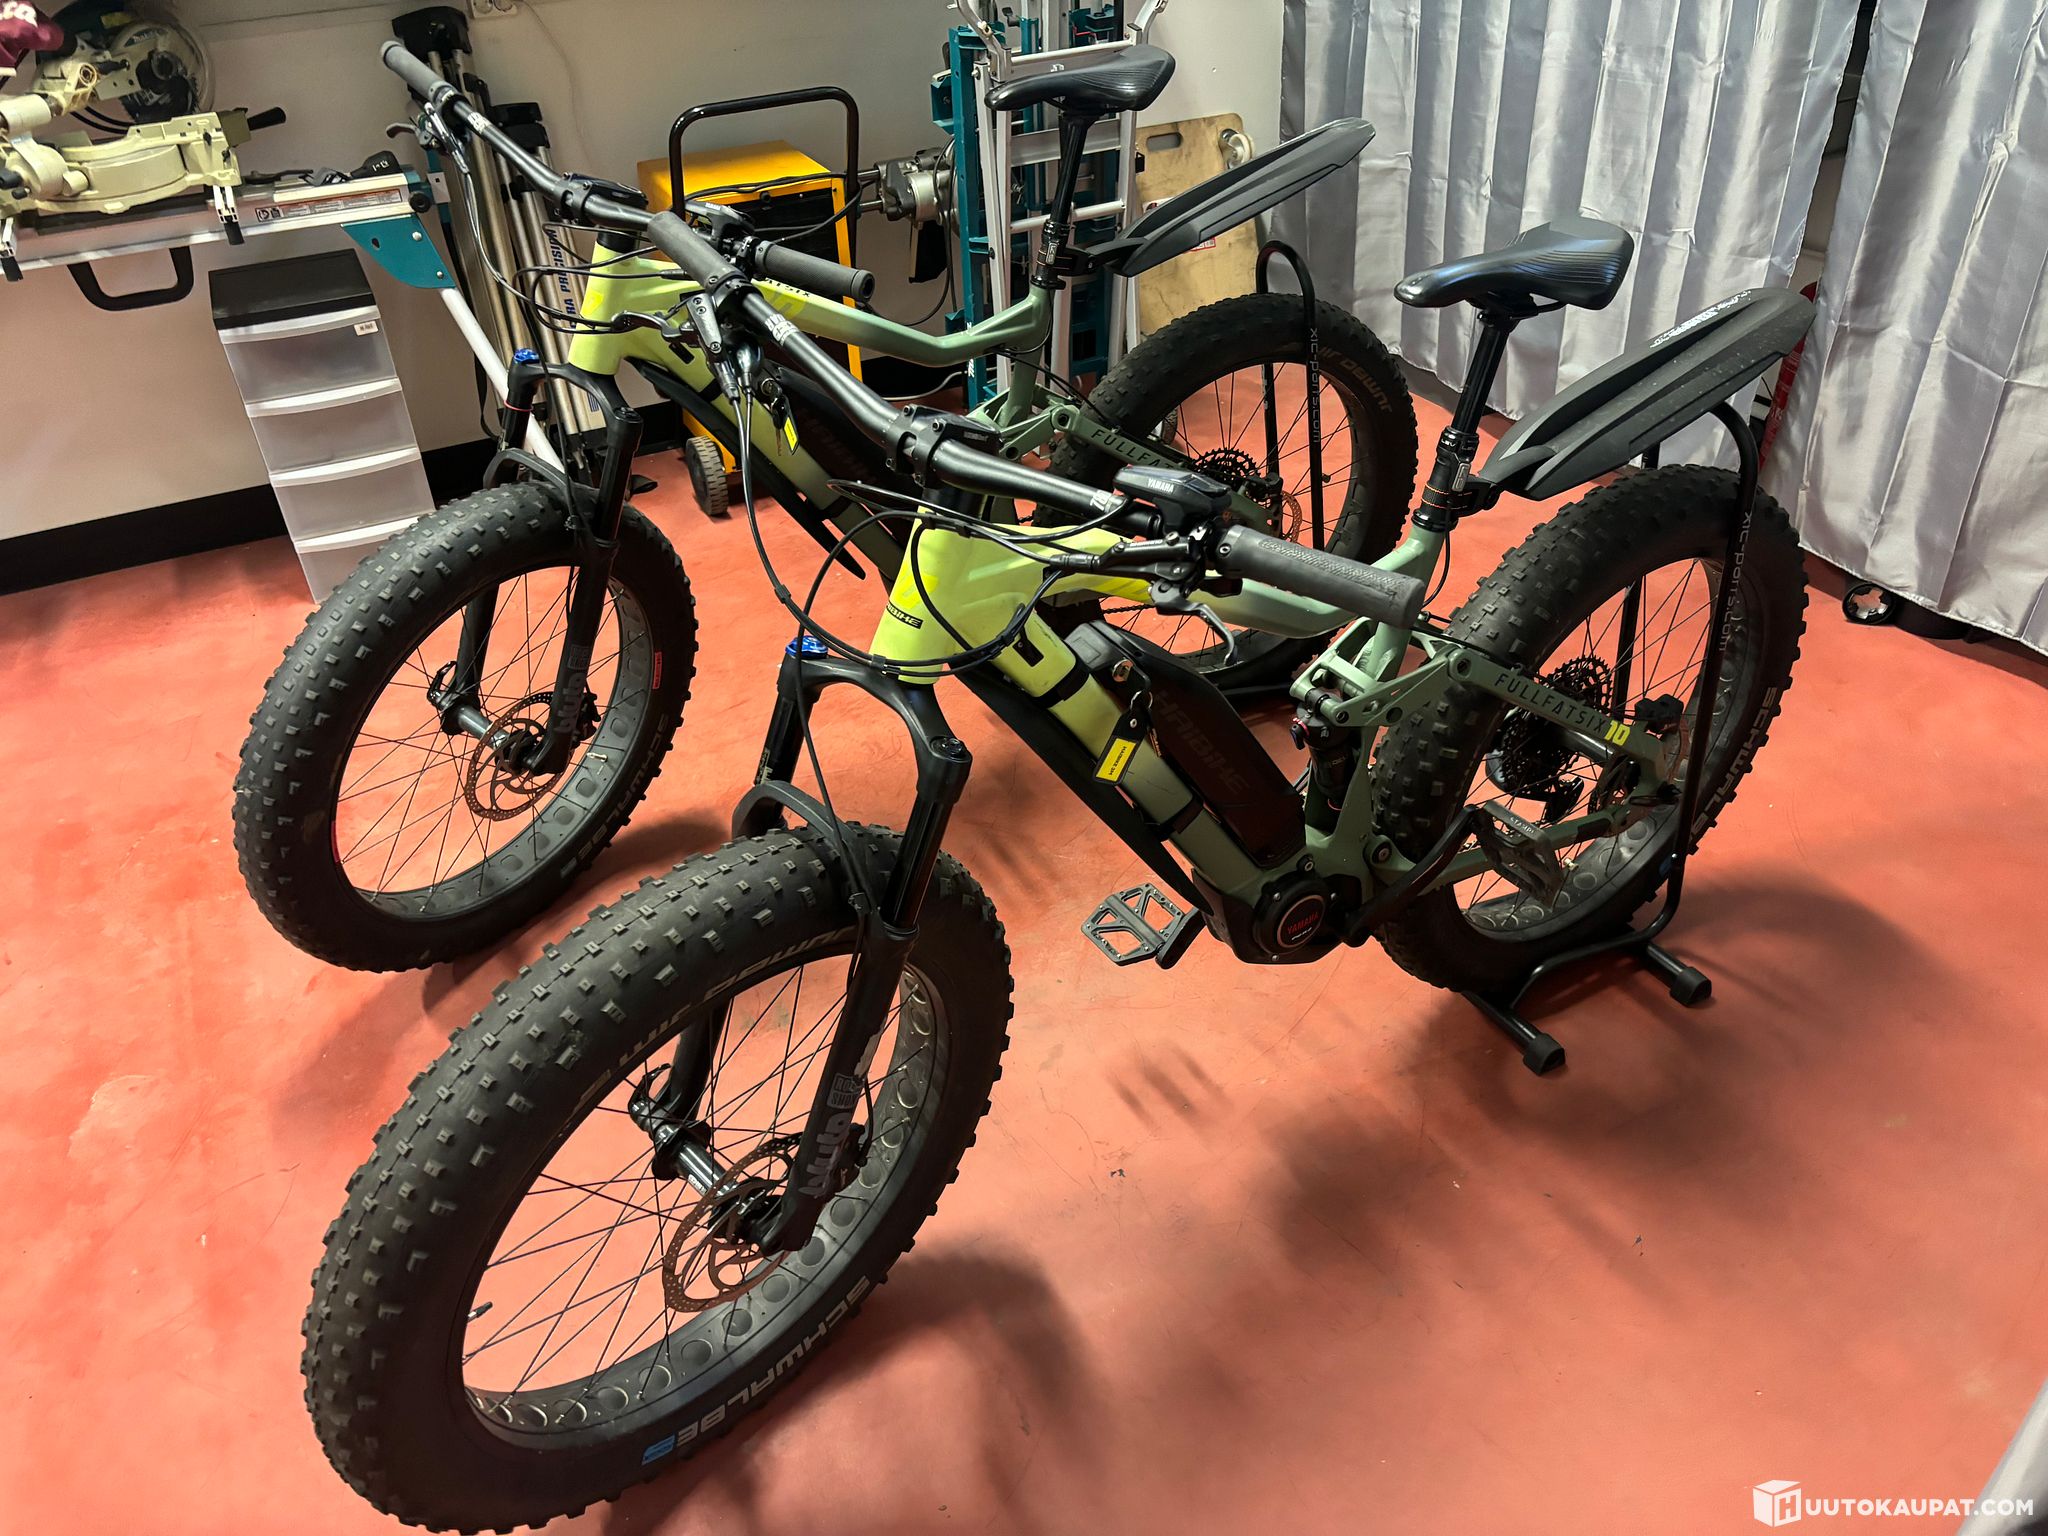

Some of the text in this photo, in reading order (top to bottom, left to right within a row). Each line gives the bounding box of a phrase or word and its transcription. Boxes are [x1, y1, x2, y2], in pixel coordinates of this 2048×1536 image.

[1147, 478, 1175, 493] YAMAHA
[1494, 673, 1631, 746] FULLFATSIX 10
[1690, 685, 1778, 854] SCHWALB
[676, 1275, 870, 1447] SCHWALBE
